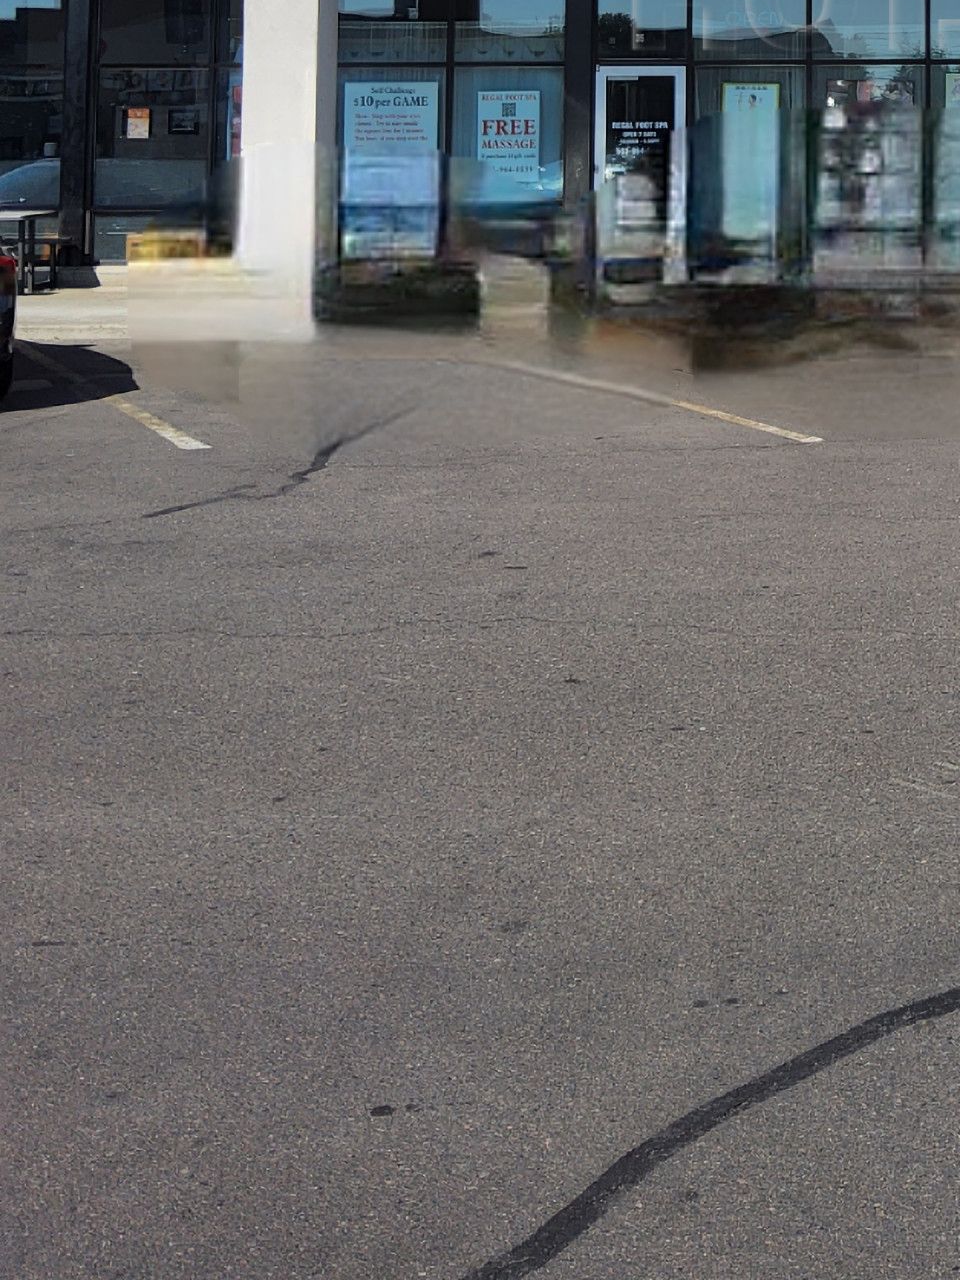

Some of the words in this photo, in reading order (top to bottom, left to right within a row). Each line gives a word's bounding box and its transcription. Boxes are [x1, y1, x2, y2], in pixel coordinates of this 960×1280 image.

[353, 96, 374, 107] $10
[375, 99, 391, 109] per
[393, 96, 429, 107] GAME
[482, 119, 537, 136] FREE
[612, 121, 634, 129] REGAL
[635, 121, 653, 129] FOOT
[482, 140, 537, 149] MASSAGE
